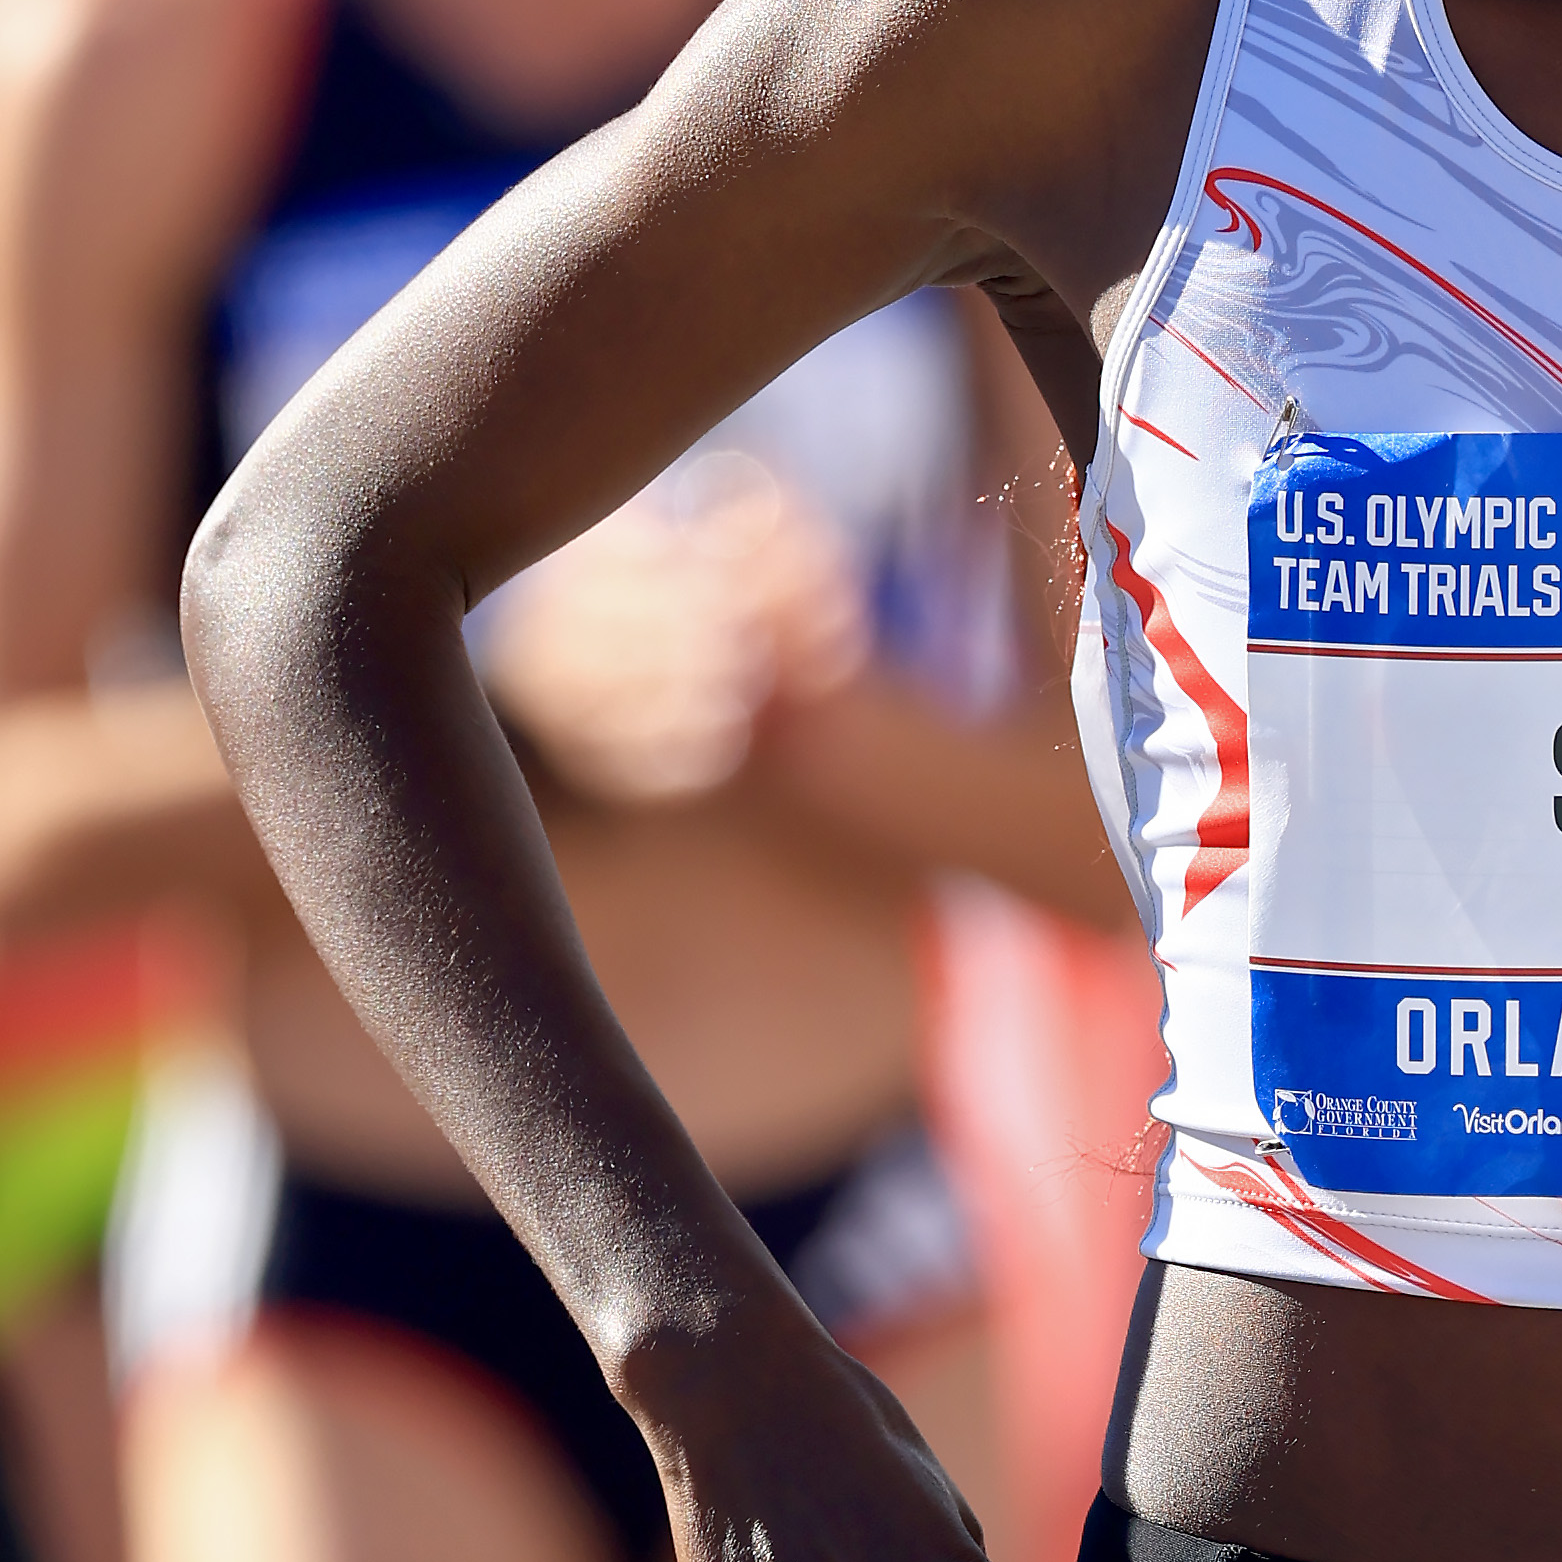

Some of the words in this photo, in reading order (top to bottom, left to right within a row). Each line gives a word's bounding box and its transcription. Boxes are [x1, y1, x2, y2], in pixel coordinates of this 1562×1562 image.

[1277, 491, 1355, 545] U.S.
[1366, 494, 1557, 549] OLYMPIC
[1273, 557, 1389, 615] TEAM
[1401, 563, 1561, 617] TRIALS
[1316, 1110, 1418, 1127] GOVERNMENT
[1318, 1124, 1417, 1139] FLORIDA
